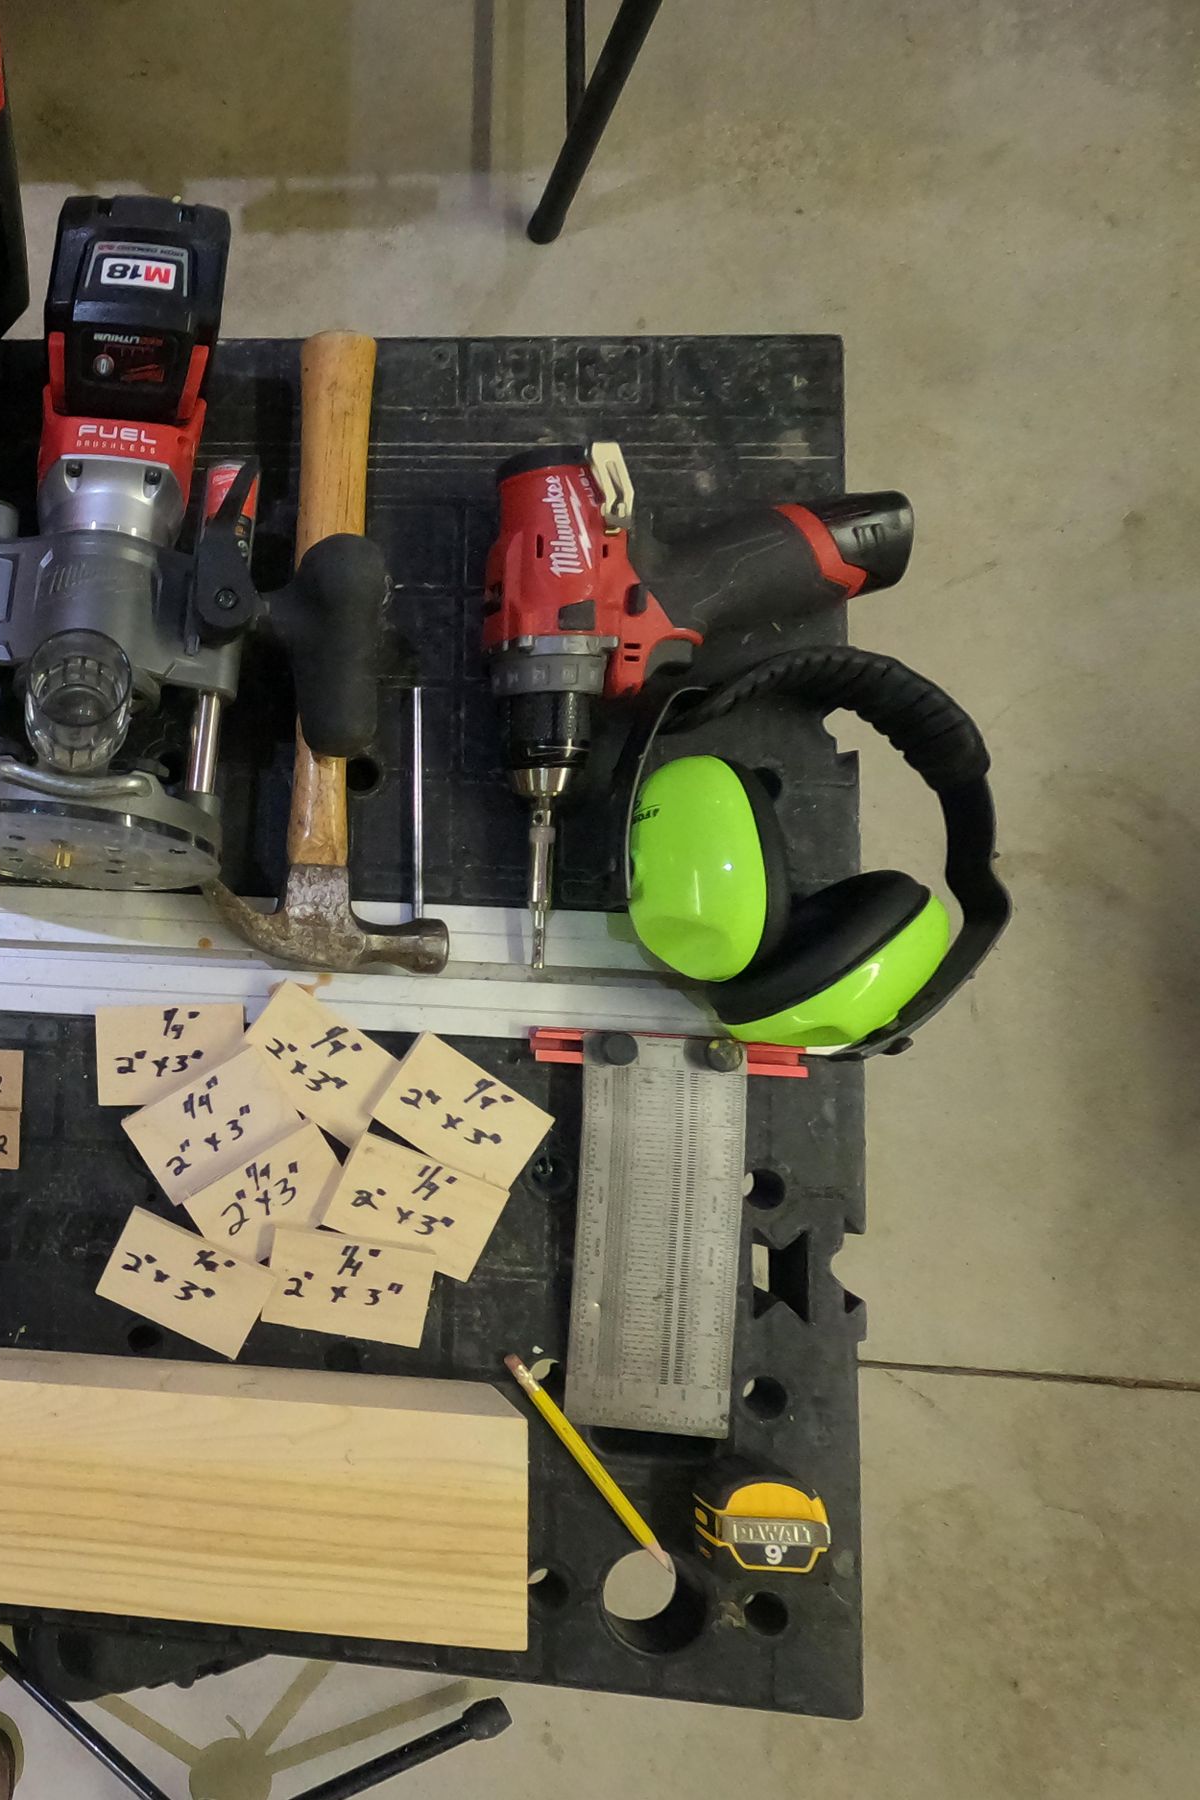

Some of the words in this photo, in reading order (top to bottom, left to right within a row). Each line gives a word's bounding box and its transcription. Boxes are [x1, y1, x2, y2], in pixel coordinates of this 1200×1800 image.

[106, 263, 171, 284] M18
[78, 424, 157, 444] FUEL
[76, 439, 156, 454] BRUSHLESS
[541, 474, 584, 577] Milwaukee
